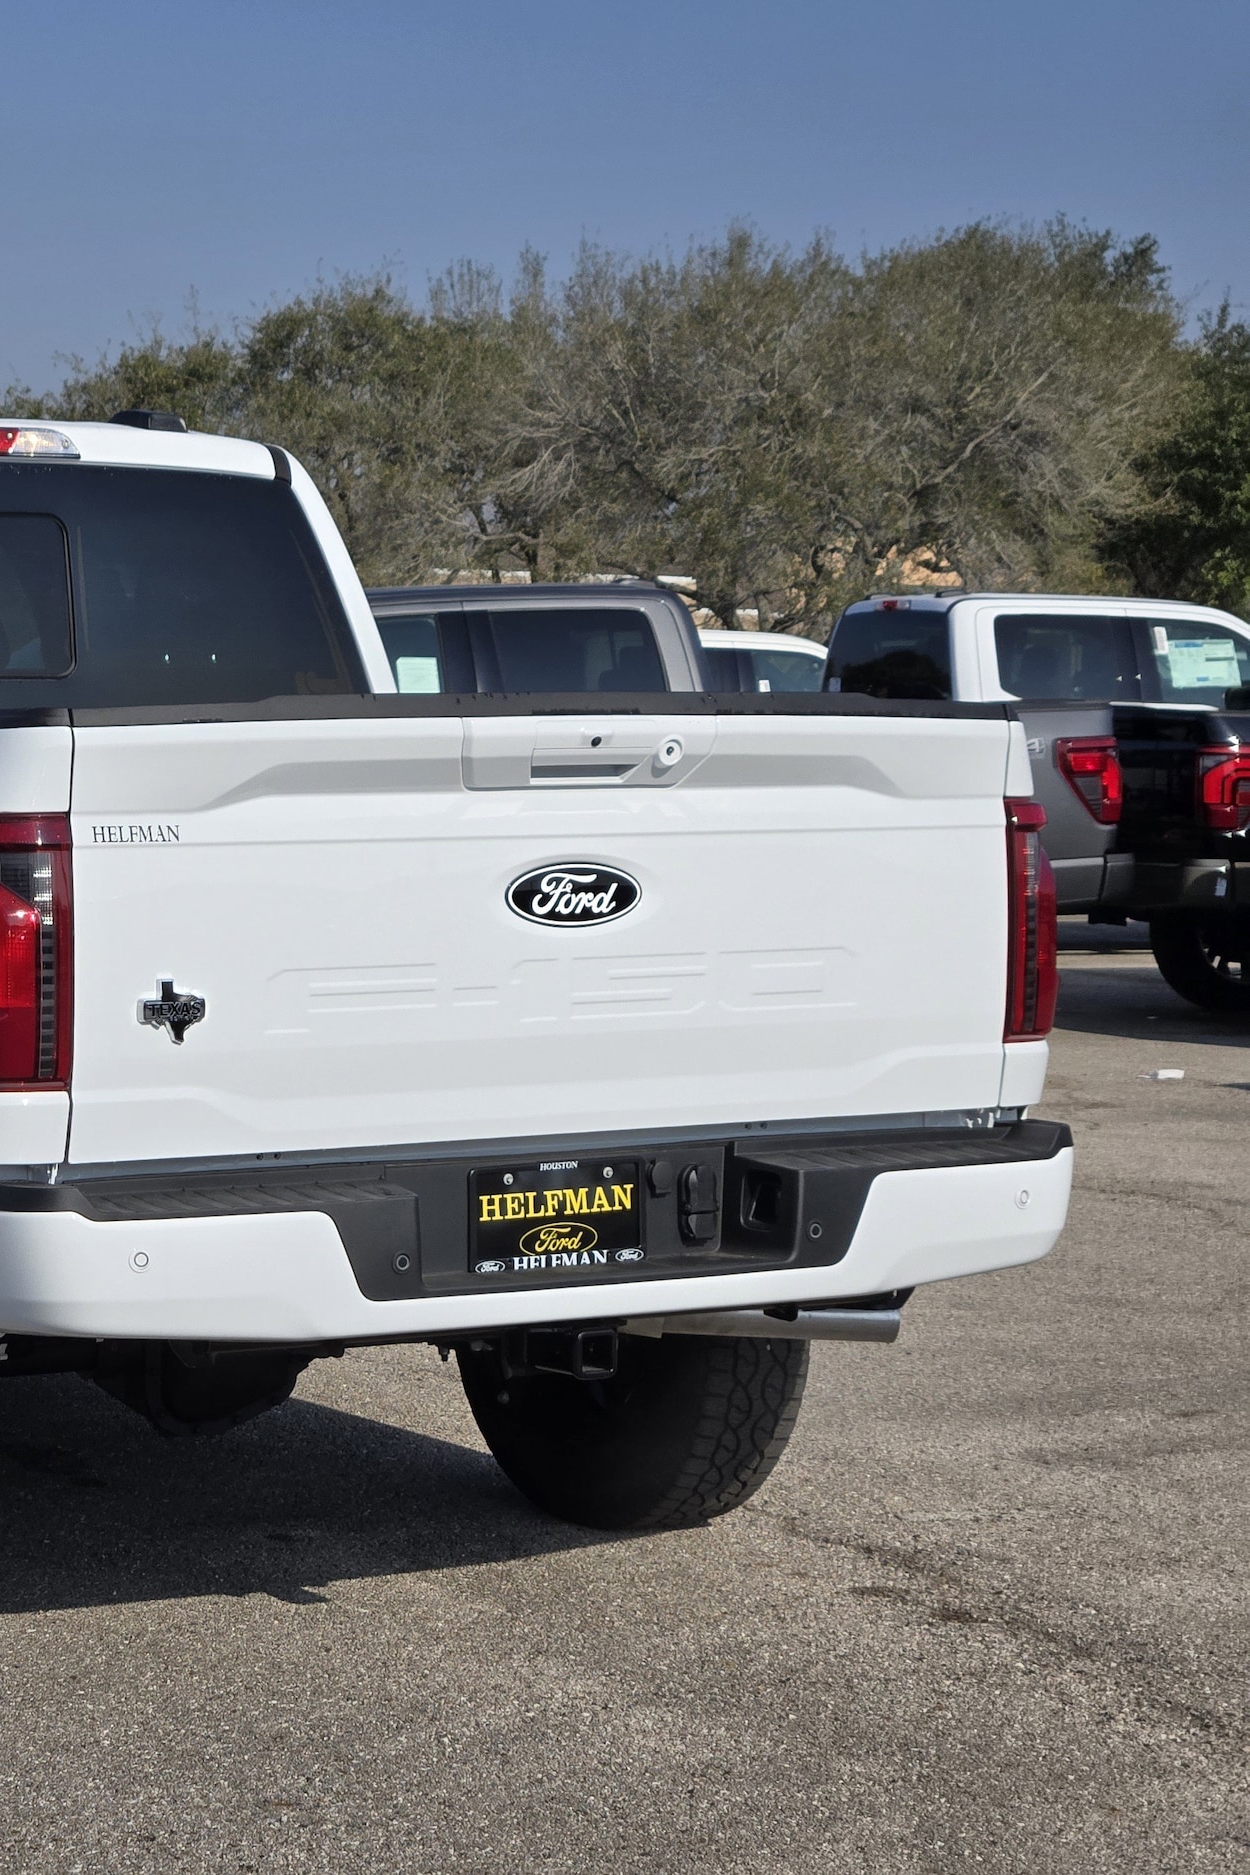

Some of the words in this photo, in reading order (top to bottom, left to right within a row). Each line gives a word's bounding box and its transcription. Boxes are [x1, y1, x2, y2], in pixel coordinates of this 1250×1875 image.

[91, 824, 180, 843] HELFMAN
[531, 872, 619, 915] Ford
[147, 1001, 202, 1017] TEXAS
[539, 1160, 579, 1172] HOUSTON
[478, 1183, 635, 1222] HELFMAN
[534, 1226, 584, 1253] Ford
